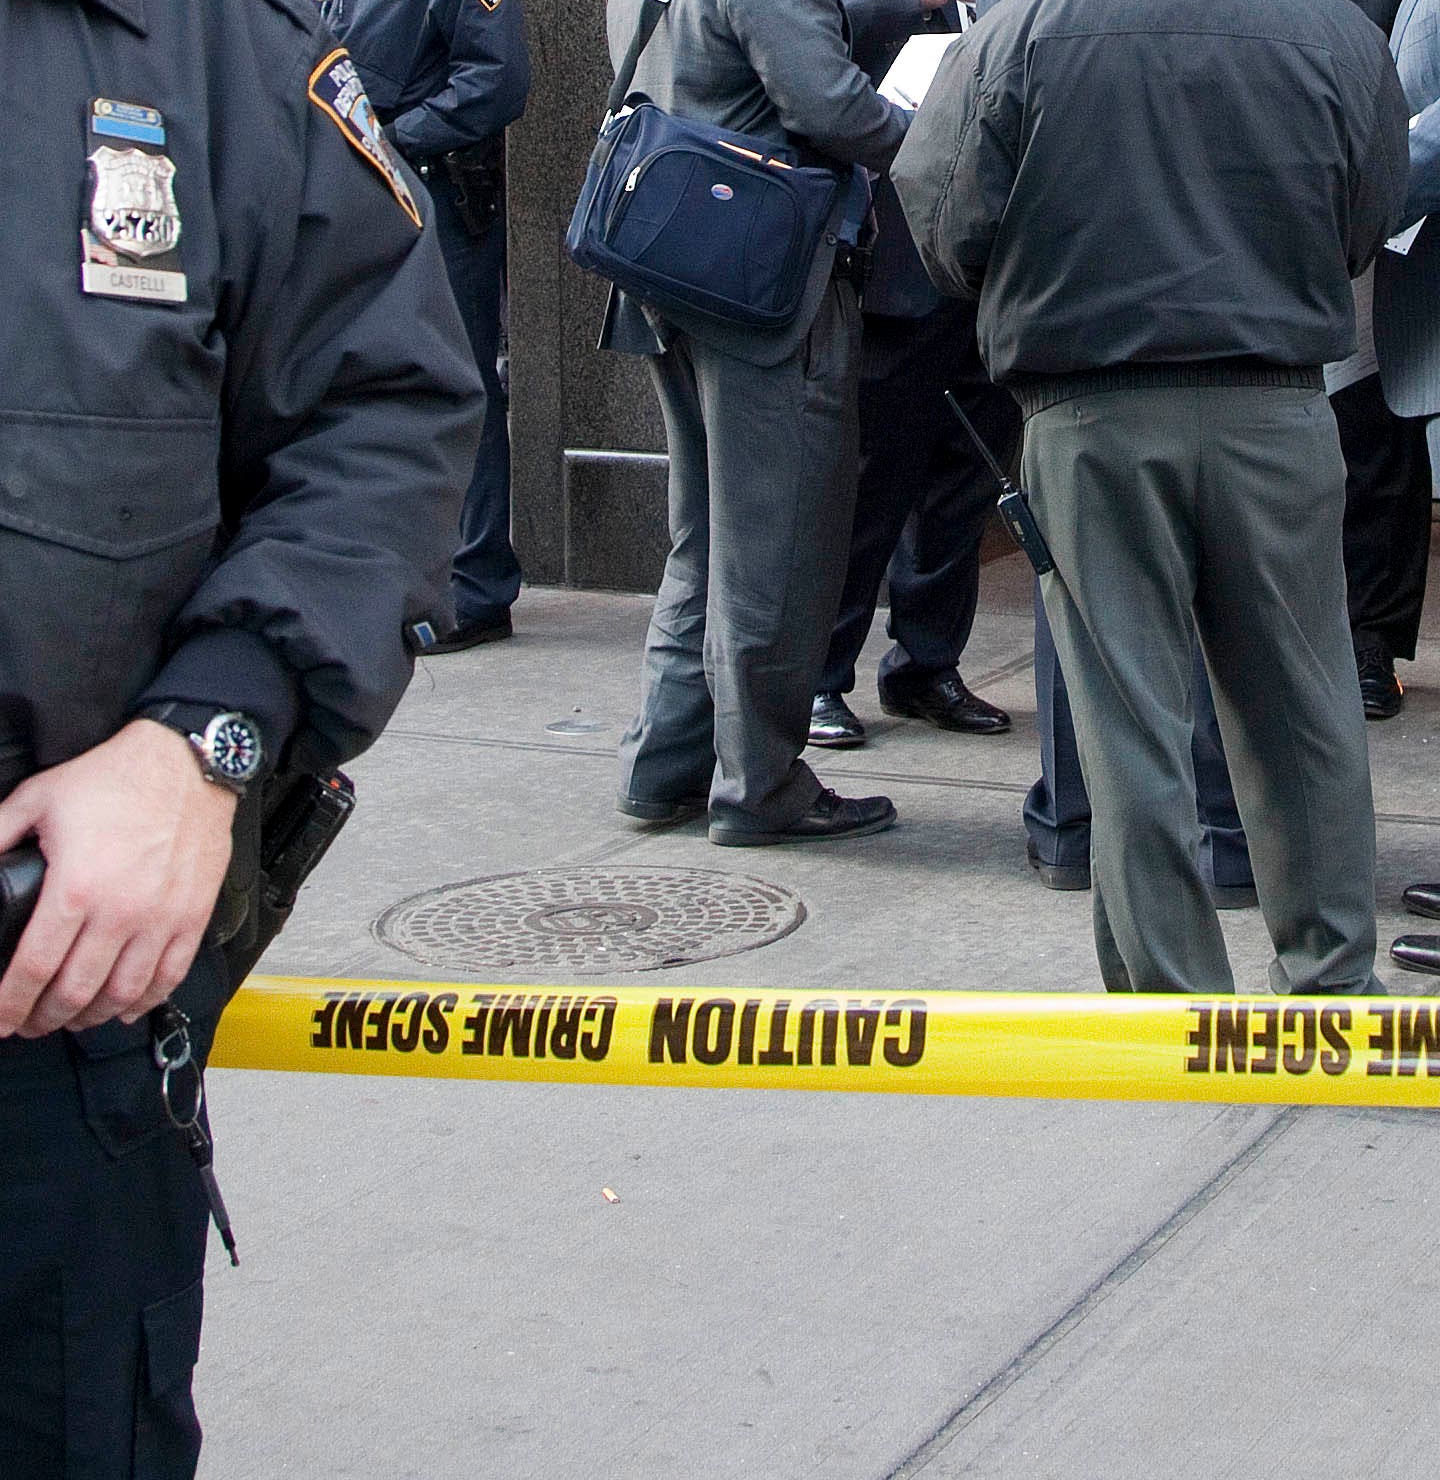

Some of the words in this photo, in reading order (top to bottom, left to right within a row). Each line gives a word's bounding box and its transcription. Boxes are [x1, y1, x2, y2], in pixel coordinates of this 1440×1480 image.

[103, 209, 175, 242] 25730
[111, 273, 166, 293] CASTELLI
[310, 989, 456, 1054] SCENE
[461, 992, 616, 1063] CRIME
[650, 997, 928, 1068] CAUTION
[1185, 998, 1353, 1075] SCENE
